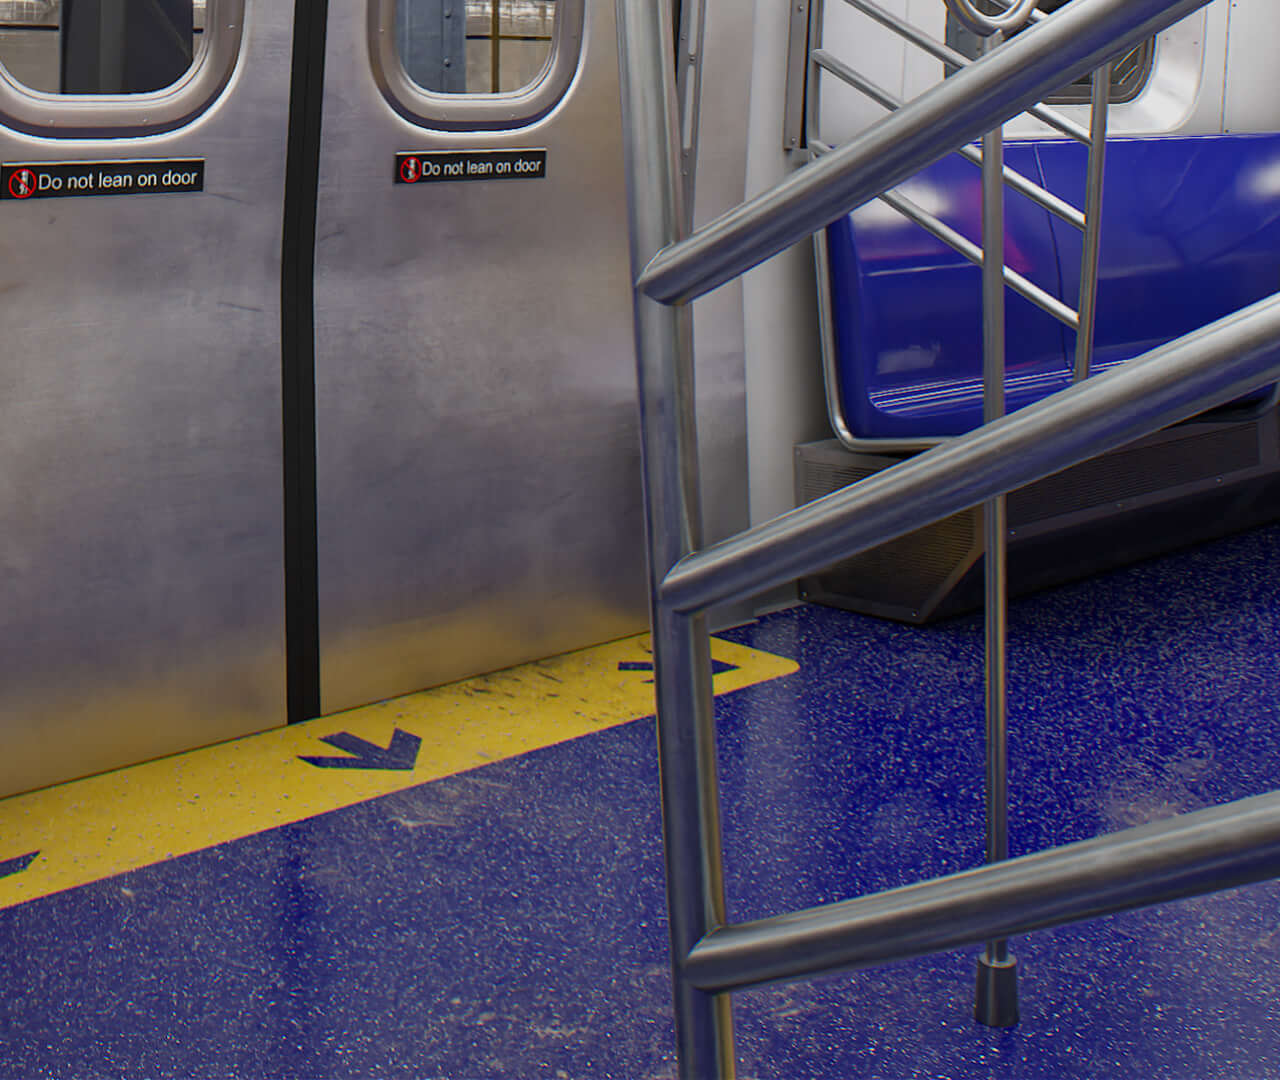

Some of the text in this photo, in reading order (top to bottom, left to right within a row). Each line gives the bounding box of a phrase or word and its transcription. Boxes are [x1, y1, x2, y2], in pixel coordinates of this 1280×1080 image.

[422, 159, 541, 176] Do not lean on door
[38, 170, 198, 190] Do not lean on door
